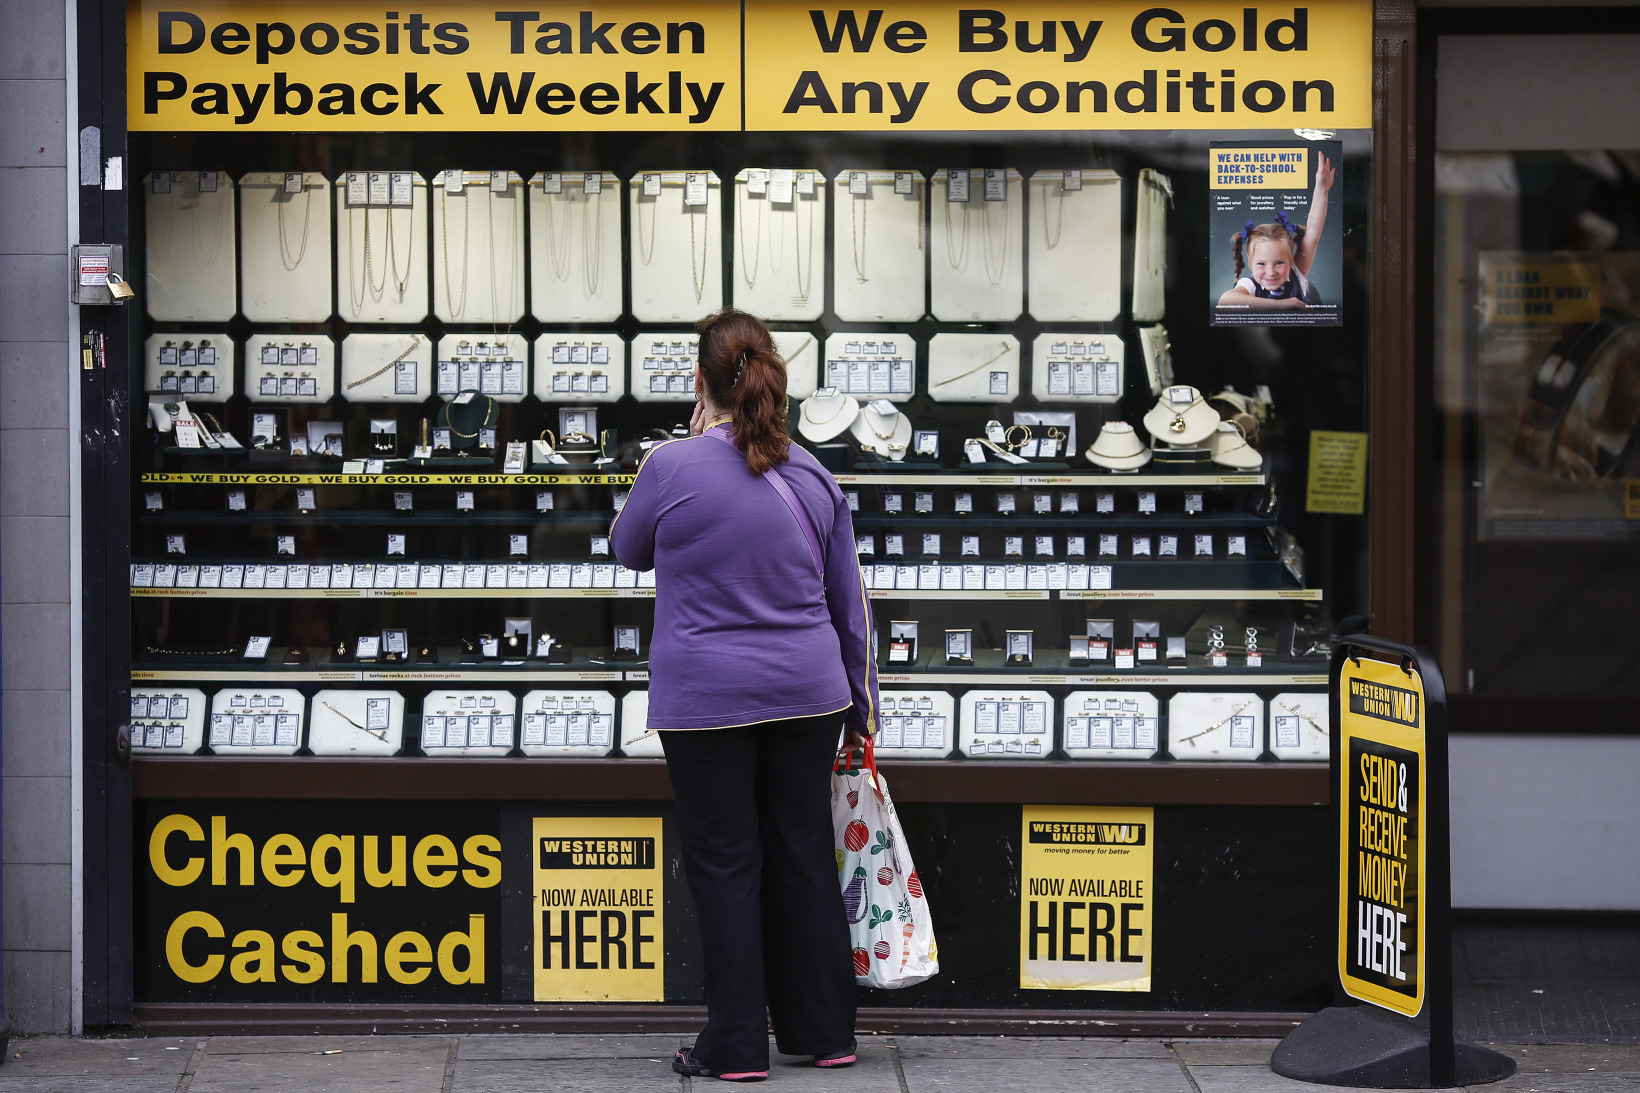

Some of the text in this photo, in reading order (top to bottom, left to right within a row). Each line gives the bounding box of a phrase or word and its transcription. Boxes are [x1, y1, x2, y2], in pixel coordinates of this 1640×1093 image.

[156, 11, 706, 65] Deposits Taken
[810, 8, 1309, 62] We Buy Gold
[143, 71, 725, 124] Payback Weekly
[782, 70, 1335, 123] Any Condition
[1217, 154, 1303, 163] WE CAN HELP WITH
[1217, 164, 1296, 174] BACK-TO-SCHOOL
[1217, 175, 1264, 185] EXPENSES
[1497, 286, 1591, 299] AGAINST WHAT
[1497, 302, 1554, 315] YOU OWN
[190, 474, 301, 483] WE BUY GOLD
[320, 475, 430, 484] WE BUY GOLD
[449, 475, 560, 484] WE BUY GOLD
[578, 475, 601, 484] WE
[1351, 681, 1391, 703] WESTERN
[1363, 698, 1390, 717] UNION
[1393, 690, 1416, 723] WU
[1360, 752, 1408, 813] SEND &
[1033, 823, 1096, 833] WESTERN
[1103, 825, 1139, 843] WU
[1359, 805, 1408, 860] RECEIVE
[544, 841, 633, 852] WESTERN
[1052, 833, 1096, 842] UNION
[150, 814, 502, 904] Cheques
[572, 853, 633, 866] UNION
[1044, 847, 1070, 855] moving
[1071, 848, 1096, 856] money
[1029, 878, 1144, 898] NOW AVAILABLE
[1359, 850, 1407, 909] MONEY
[541, 889, 654, 907] NOW AVAILABLE
[542, 910, 656, 970] HERE
[1029, 901, 1144, 963] HERE
[1357, 900, 1407, 981] HERE
[166, 911, 485, 985] Cashed
